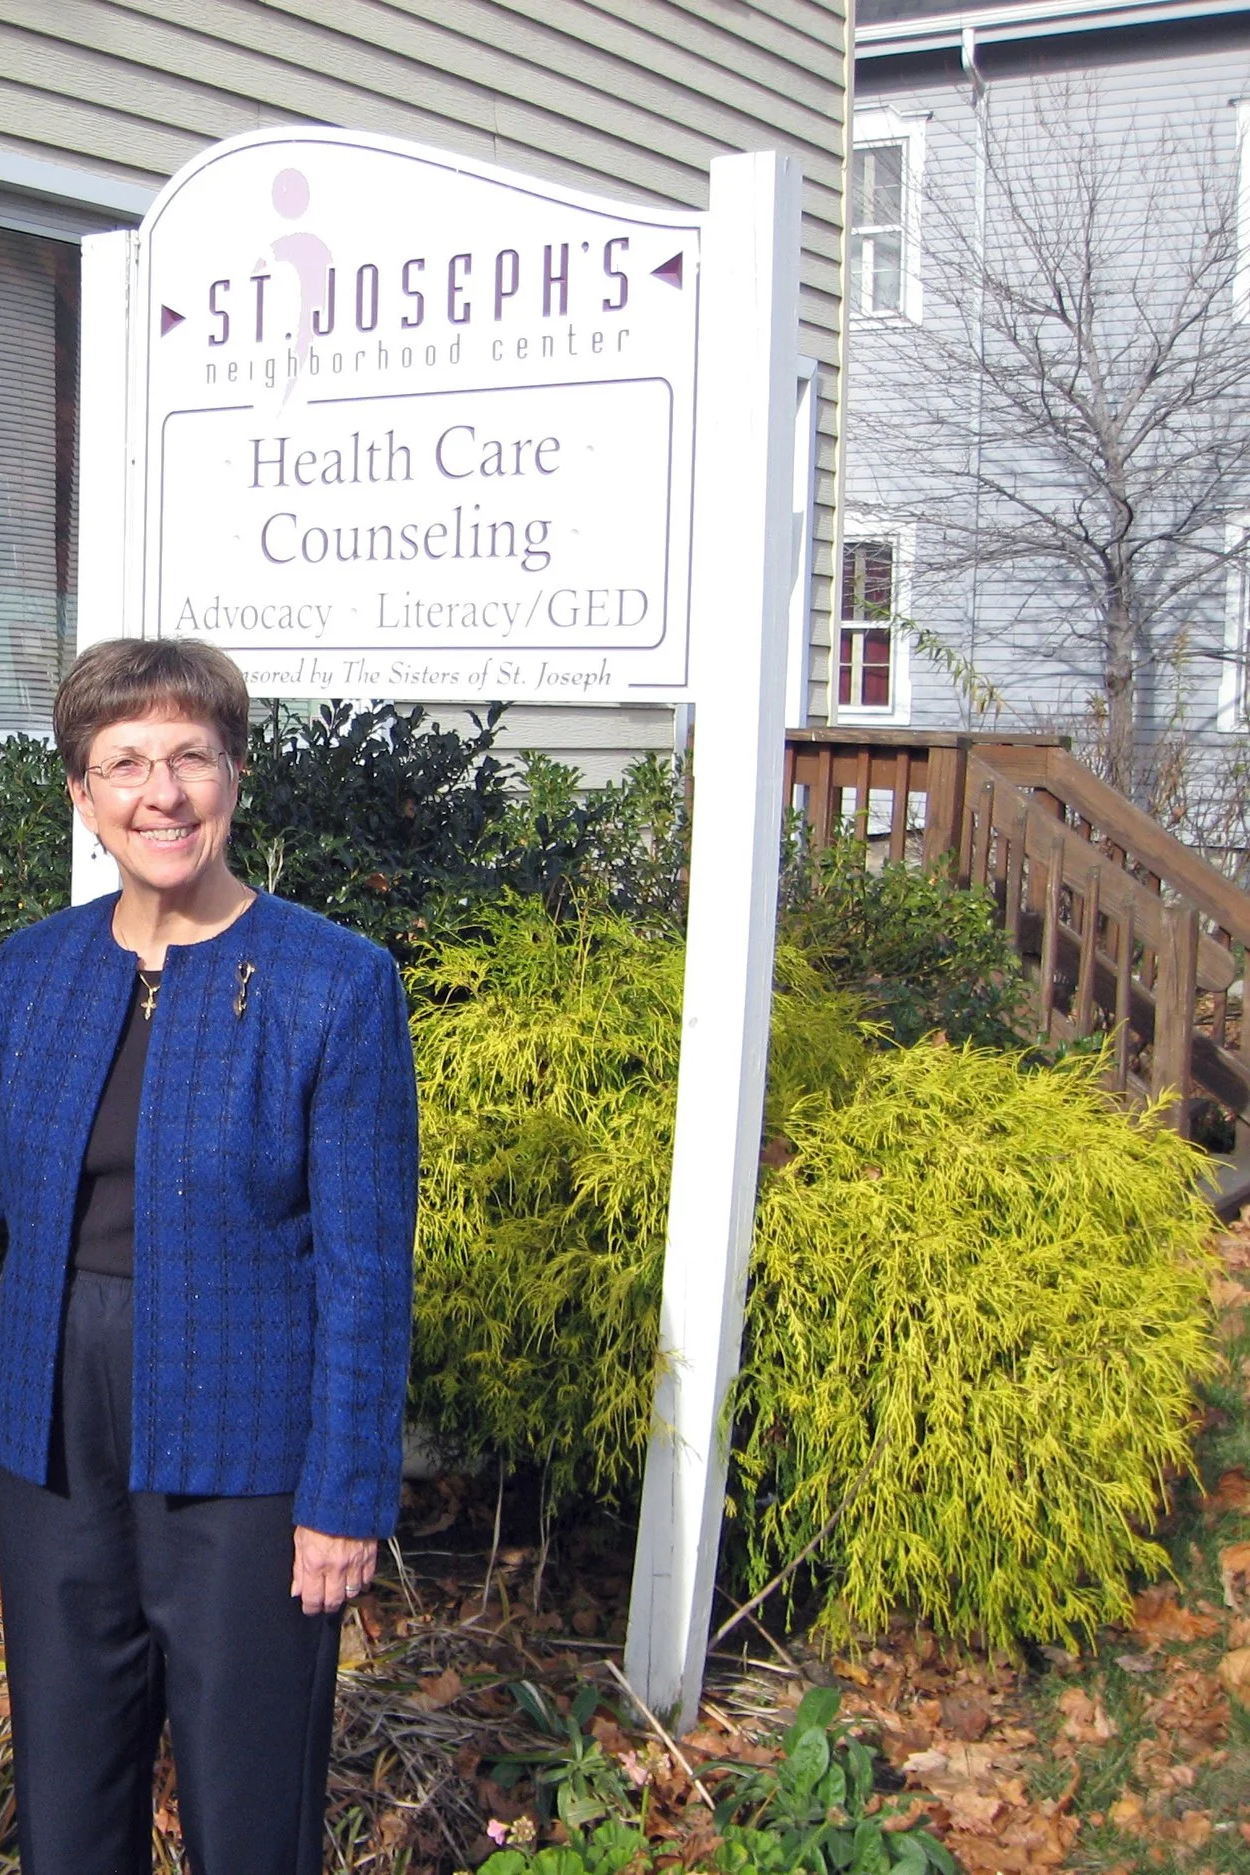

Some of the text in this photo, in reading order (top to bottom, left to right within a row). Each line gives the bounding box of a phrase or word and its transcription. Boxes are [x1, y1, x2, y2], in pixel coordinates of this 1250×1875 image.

[208, 237, 630, 347] ST. JOSEPH'S
[206, 324, 630, 388] neighborhood center
[248, 425, 561, 488] Health Care
[261, 504, 552, 572] Counseling
[175, 588, 648, 637] Advocacy Literacy/GED
[310, 657, 333, 690] by
[343, 658, 381, 686] The
[388, 659, 460, 686] Sisters
[468, 658, 492, 691] of
[496, 661, 527, 686] St.
[535, 658, 612, 692] Joseph
